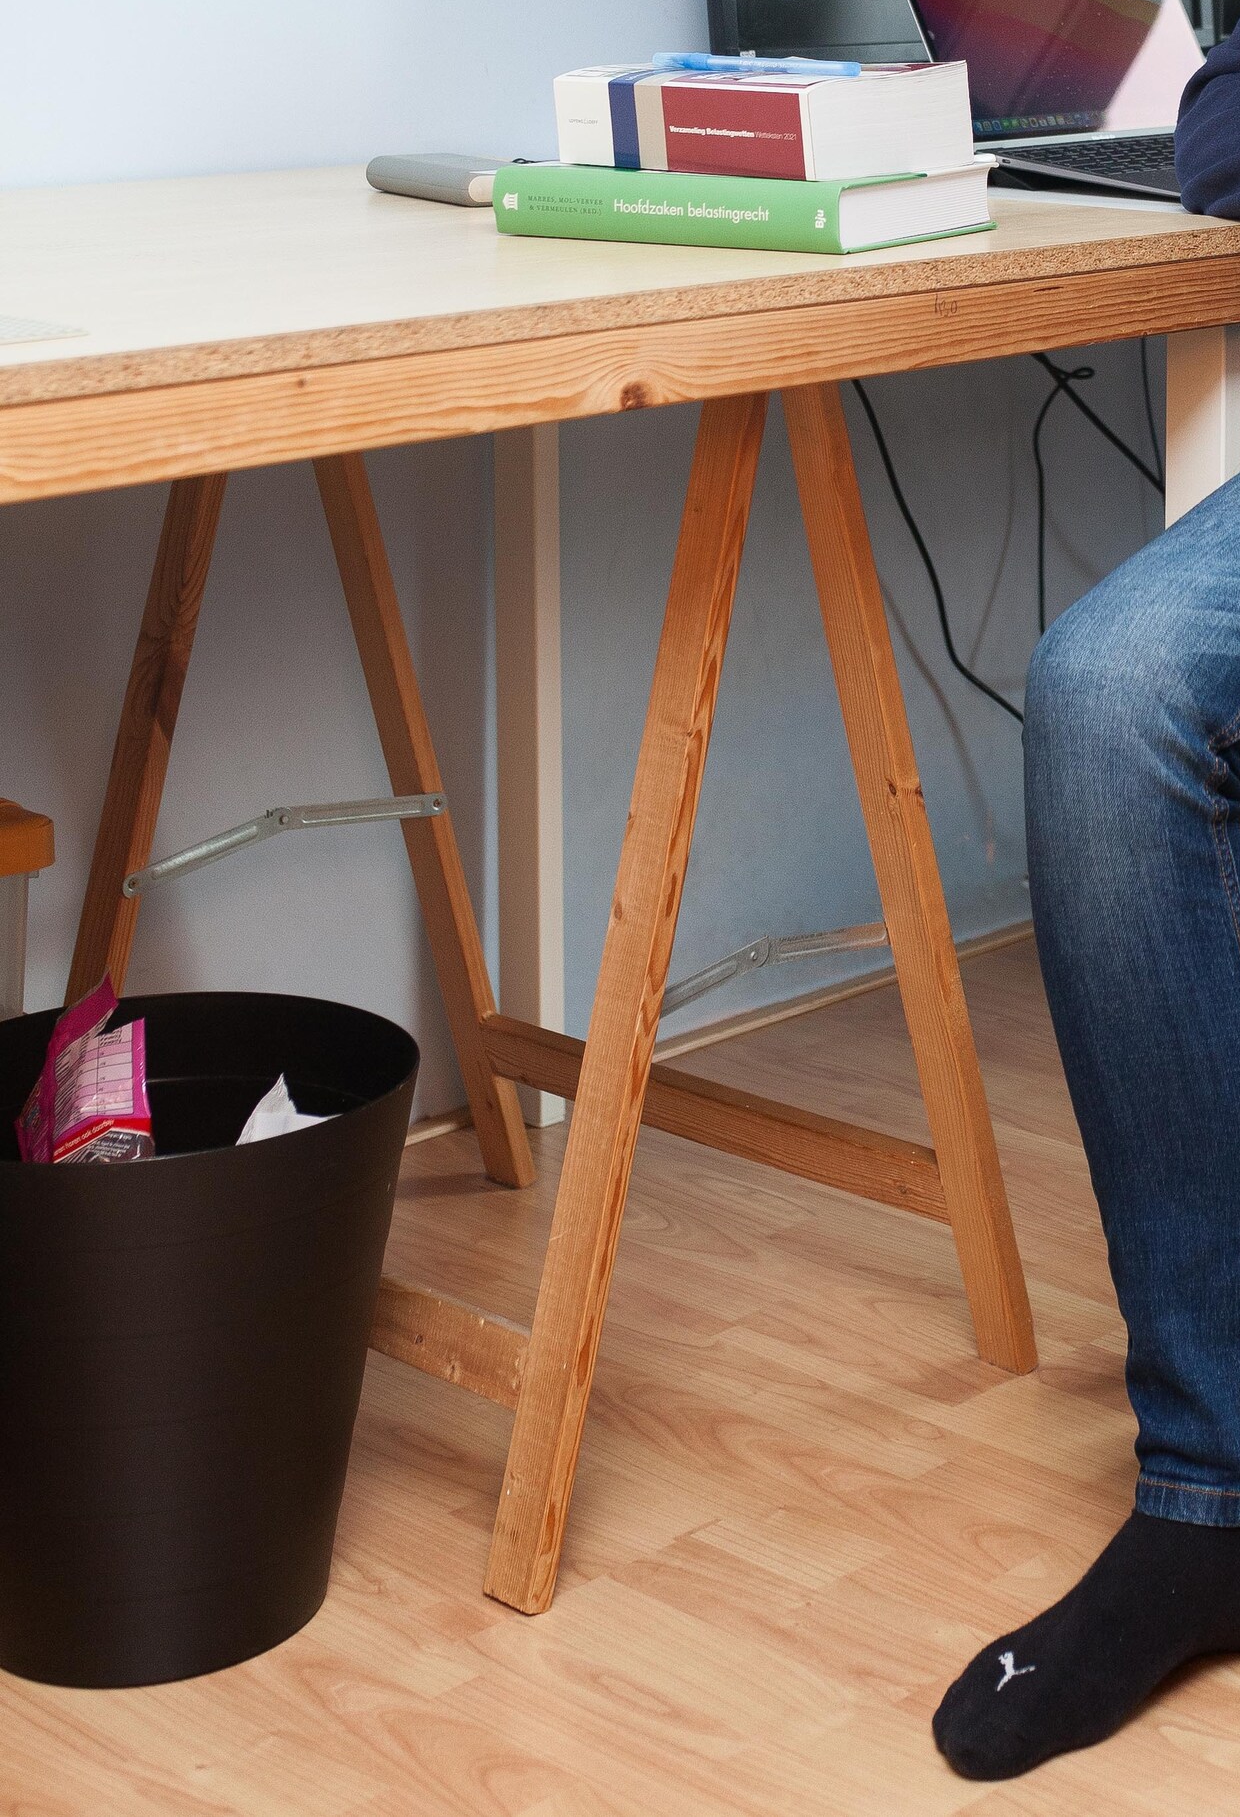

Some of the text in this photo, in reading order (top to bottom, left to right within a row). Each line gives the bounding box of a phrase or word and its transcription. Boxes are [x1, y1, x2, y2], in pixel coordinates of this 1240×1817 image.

[669, 125, 706, 136] Verzameling
[614, 199, 770, 224] Hoofdzaken belastingrecht
